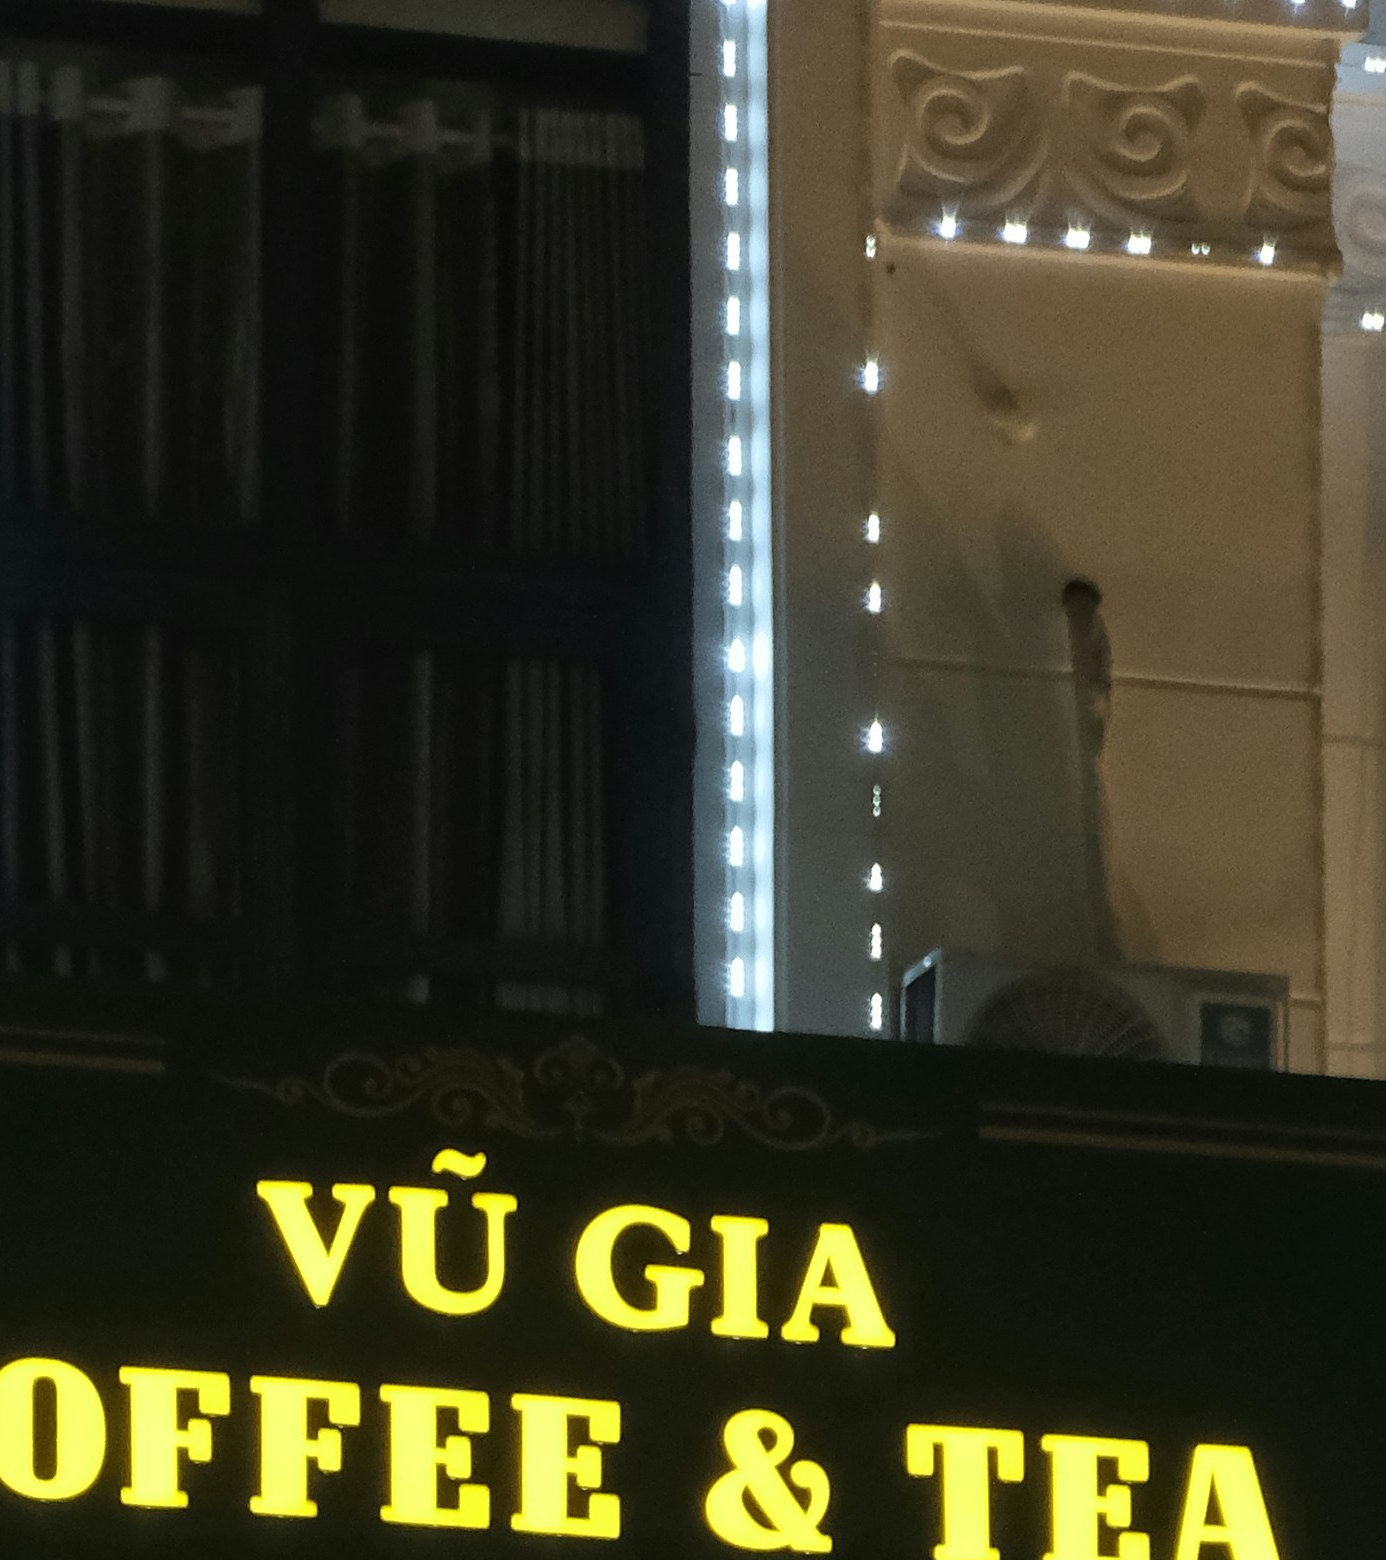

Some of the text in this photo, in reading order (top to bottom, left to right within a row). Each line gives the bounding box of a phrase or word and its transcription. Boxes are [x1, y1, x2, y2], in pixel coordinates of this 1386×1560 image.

[253, 1146, 899, 1351] VŨ GIA
[702, 1406, 835, 1557] &
